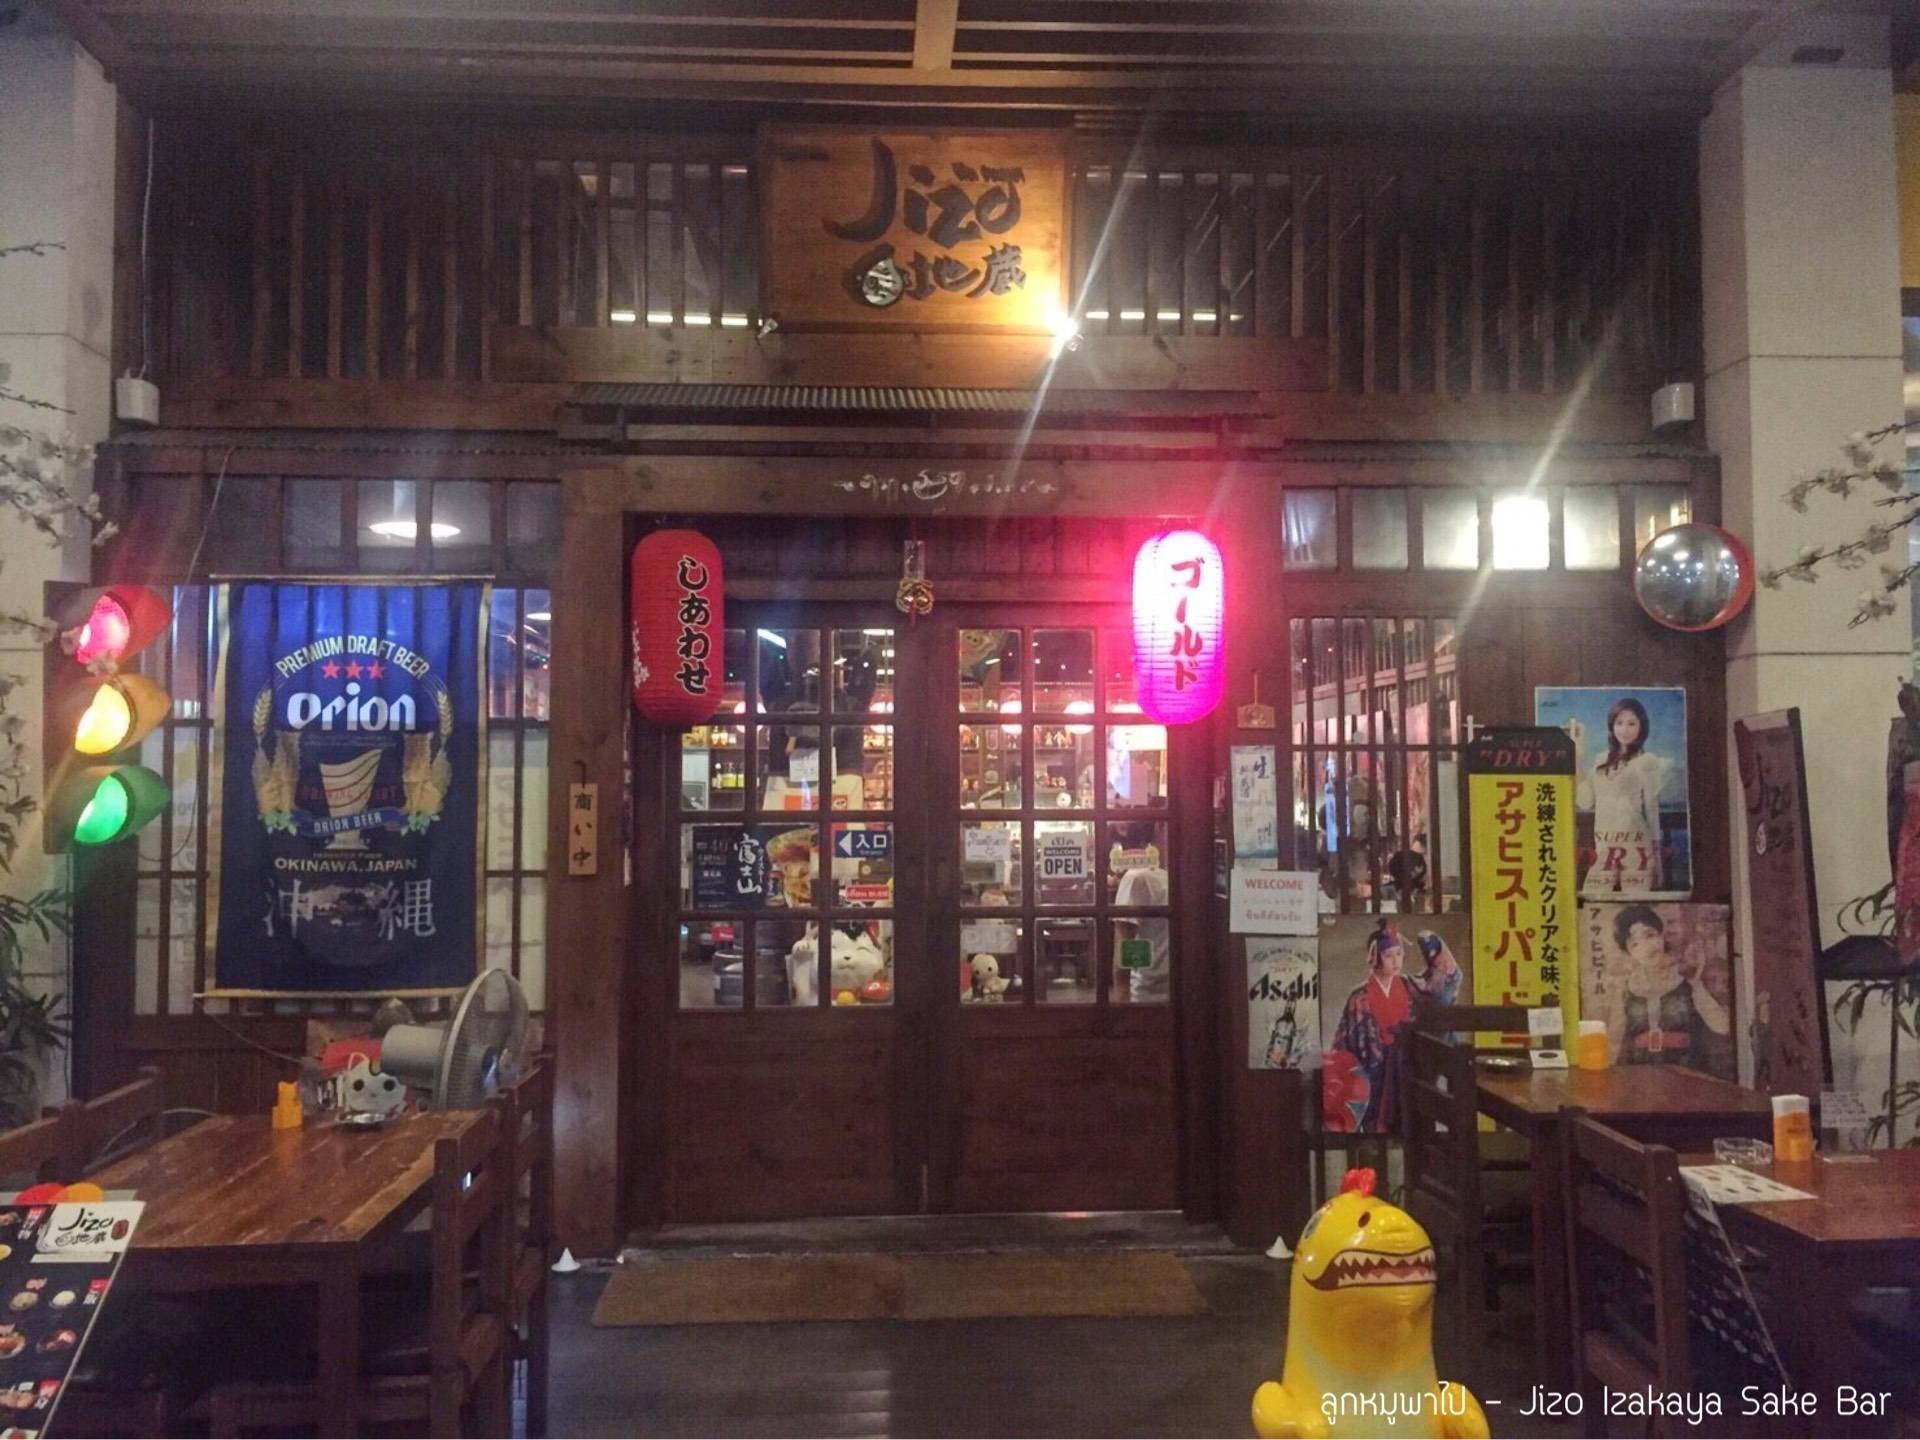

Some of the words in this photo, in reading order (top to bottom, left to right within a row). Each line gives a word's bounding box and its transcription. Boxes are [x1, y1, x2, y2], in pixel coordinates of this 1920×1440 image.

[675, 555, 712, 694] しあわせ
[1170, 557, 1206, 691] ゴールド
[275, 635, 344, 679] PREMIUM
[347, 634, 396, 659] DRAFT
[393, 646, 431, 679] BEER
[313, 816, 350, 834] ORION
[353, 811, 383, 829] BEER
[1594, 831, 1646, 843] SUPER
[855, 833, 888, 849] 入口
[733, 832, 763, 895] 富士山
[1044, 858, 1083, 875] OPEN
[1245, 878, 1304, 891] WELCOME
[261, 877, 437, 941] 沖縄
[1589, 906, 1607, 996] アサヒビール
[1249, 972, 1318, 1001] Asahi
[58, 1208, 114, 1232] Jizo
